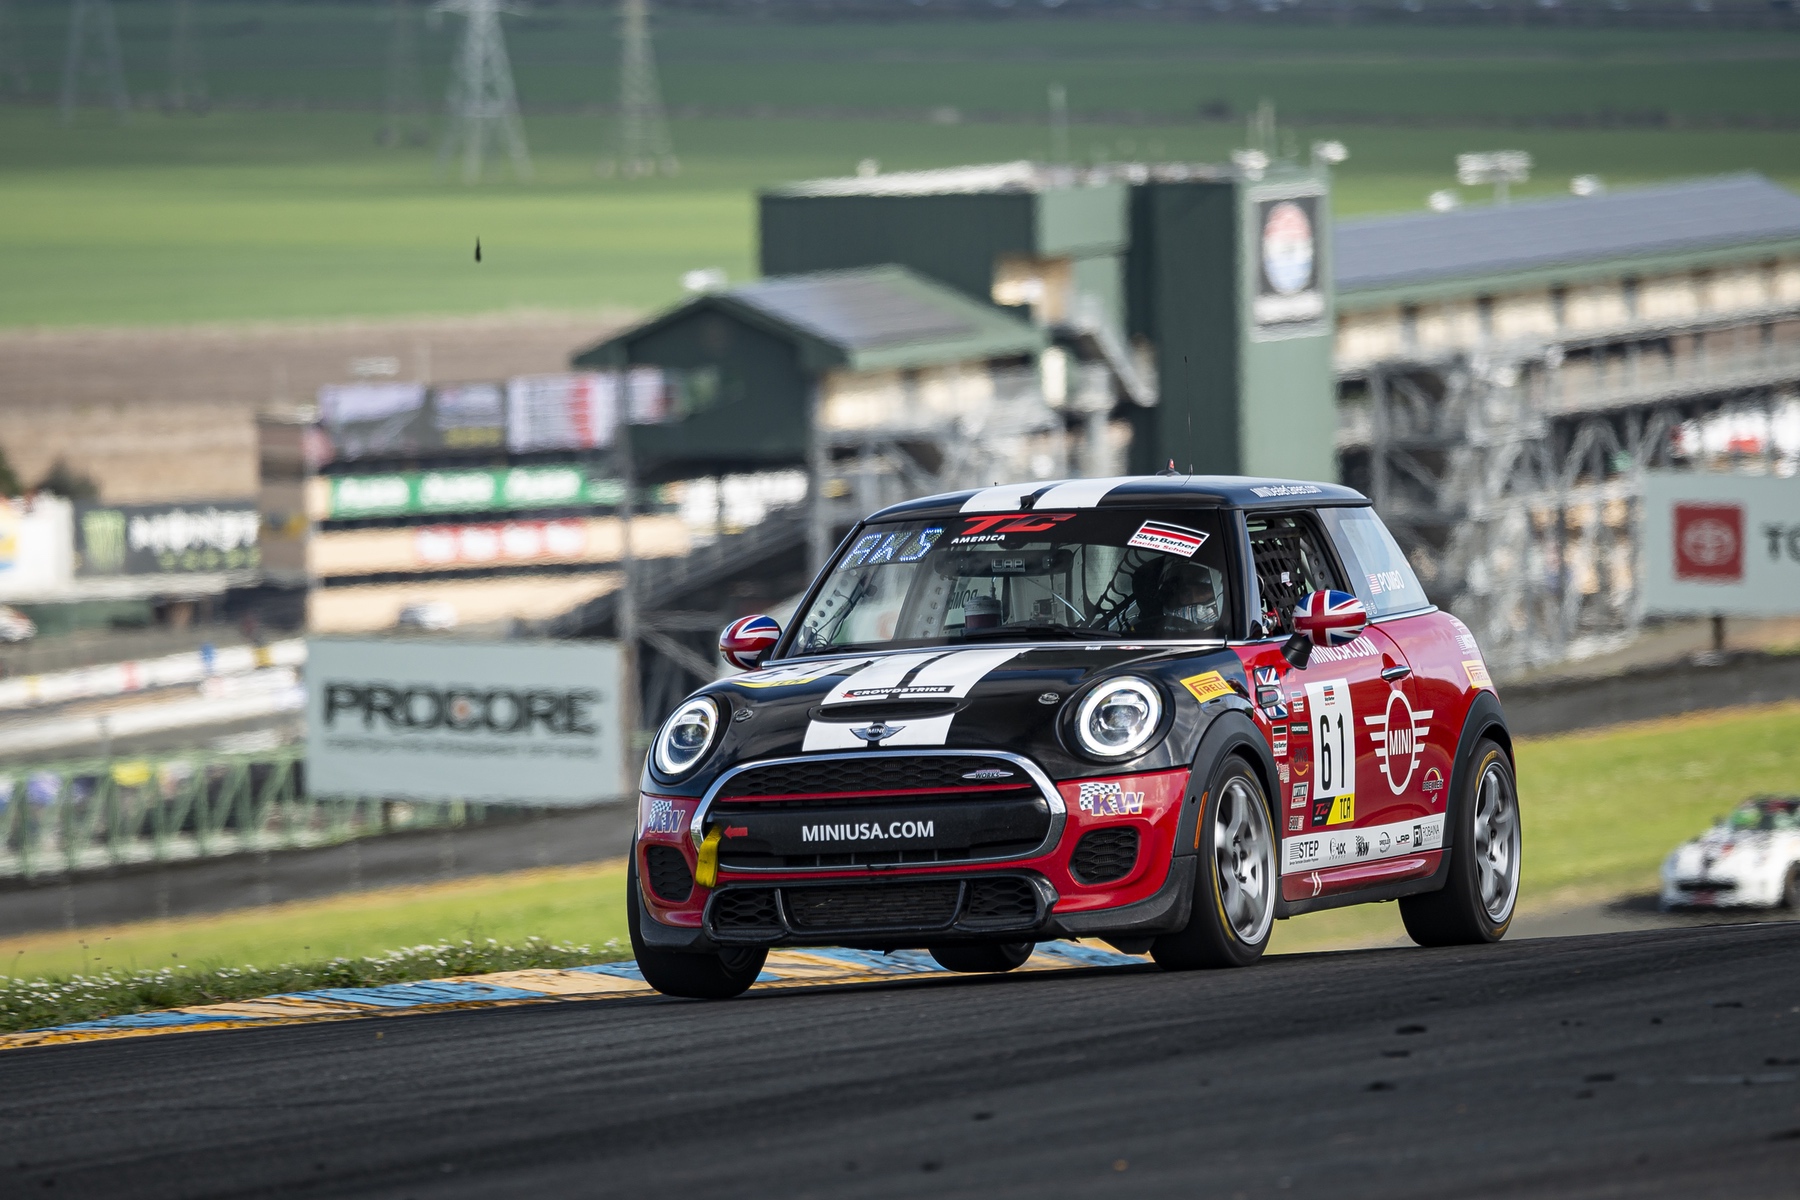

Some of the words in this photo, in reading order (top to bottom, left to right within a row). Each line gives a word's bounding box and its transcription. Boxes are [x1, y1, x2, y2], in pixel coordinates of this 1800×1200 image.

[962, 513, 1077, 535] TC
[950, 534, 1006, 545] AMERICA
[1130, 539, 1161, 549] Racing
[1162, 544, 1193, 556] School
[1135, 533, 1159, 543] Skip
[1159, 536, 1197, 550] Barber
[992, 558, 1024, 570] LAP
[1376, 570, 1405, 592] POMBO
[853, 686, 947, 697] CROWDSTRIKE
[1188, 675, 1227, 697] PIRELLI
[324, 680, 602, 736] PROCORE
[867, 727, 886, 735] MINI
[1389, 728, 1412, 756] MINI
[1319, 712, 1345, 791] 61
[975, 771, 1000, 780] WORKS
[1091, 791, 1145, 817] KW
[1340, 797, 1351, 820] TCA
[649, 809, 687, 834] KW
[802, 820, 934, 842] MINIUSA.COM
[1299, 840, 1320, 859] STEP
[1395, 834, 1410, 844] LAP
